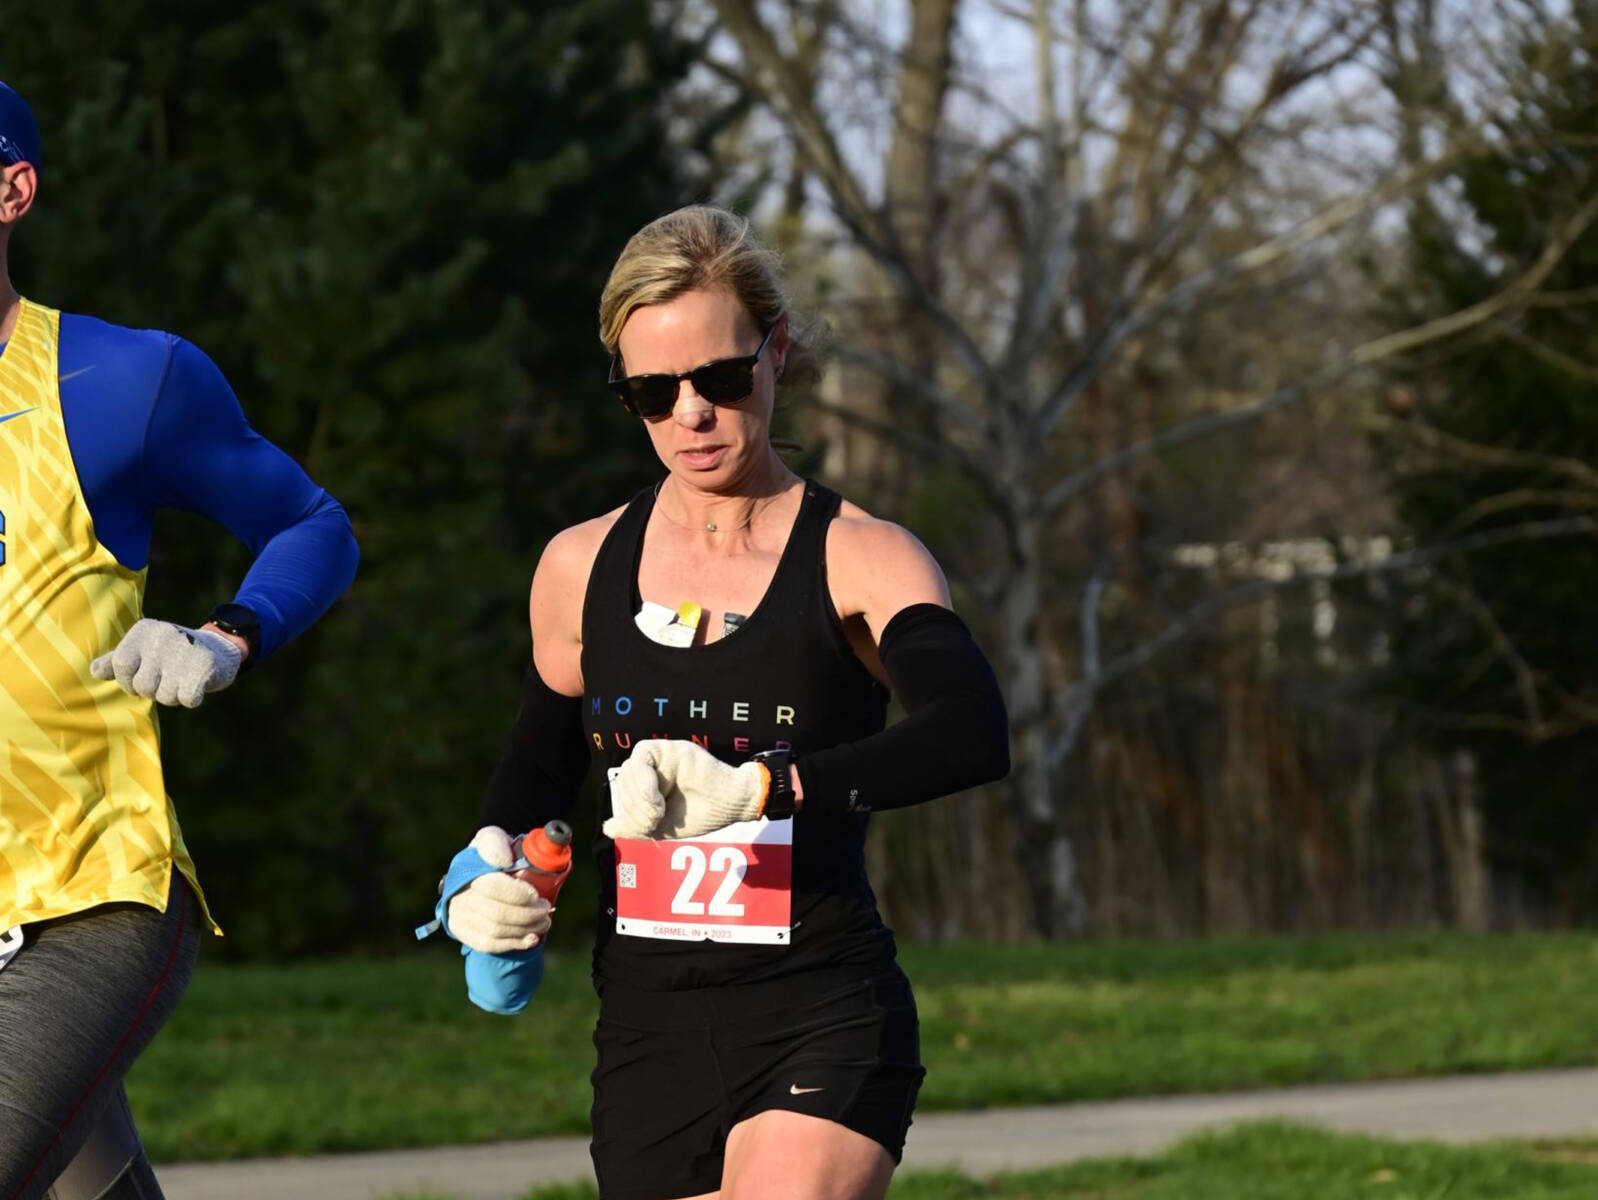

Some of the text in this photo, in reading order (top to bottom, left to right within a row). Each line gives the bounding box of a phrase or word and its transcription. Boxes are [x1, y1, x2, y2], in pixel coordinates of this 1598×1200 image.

[592, 696, 796, 725] MOTHER
[592, 732, 792, 752] RUNER
[670, 845, 748, 917] 22
[692, 928, 701, 937] IN
